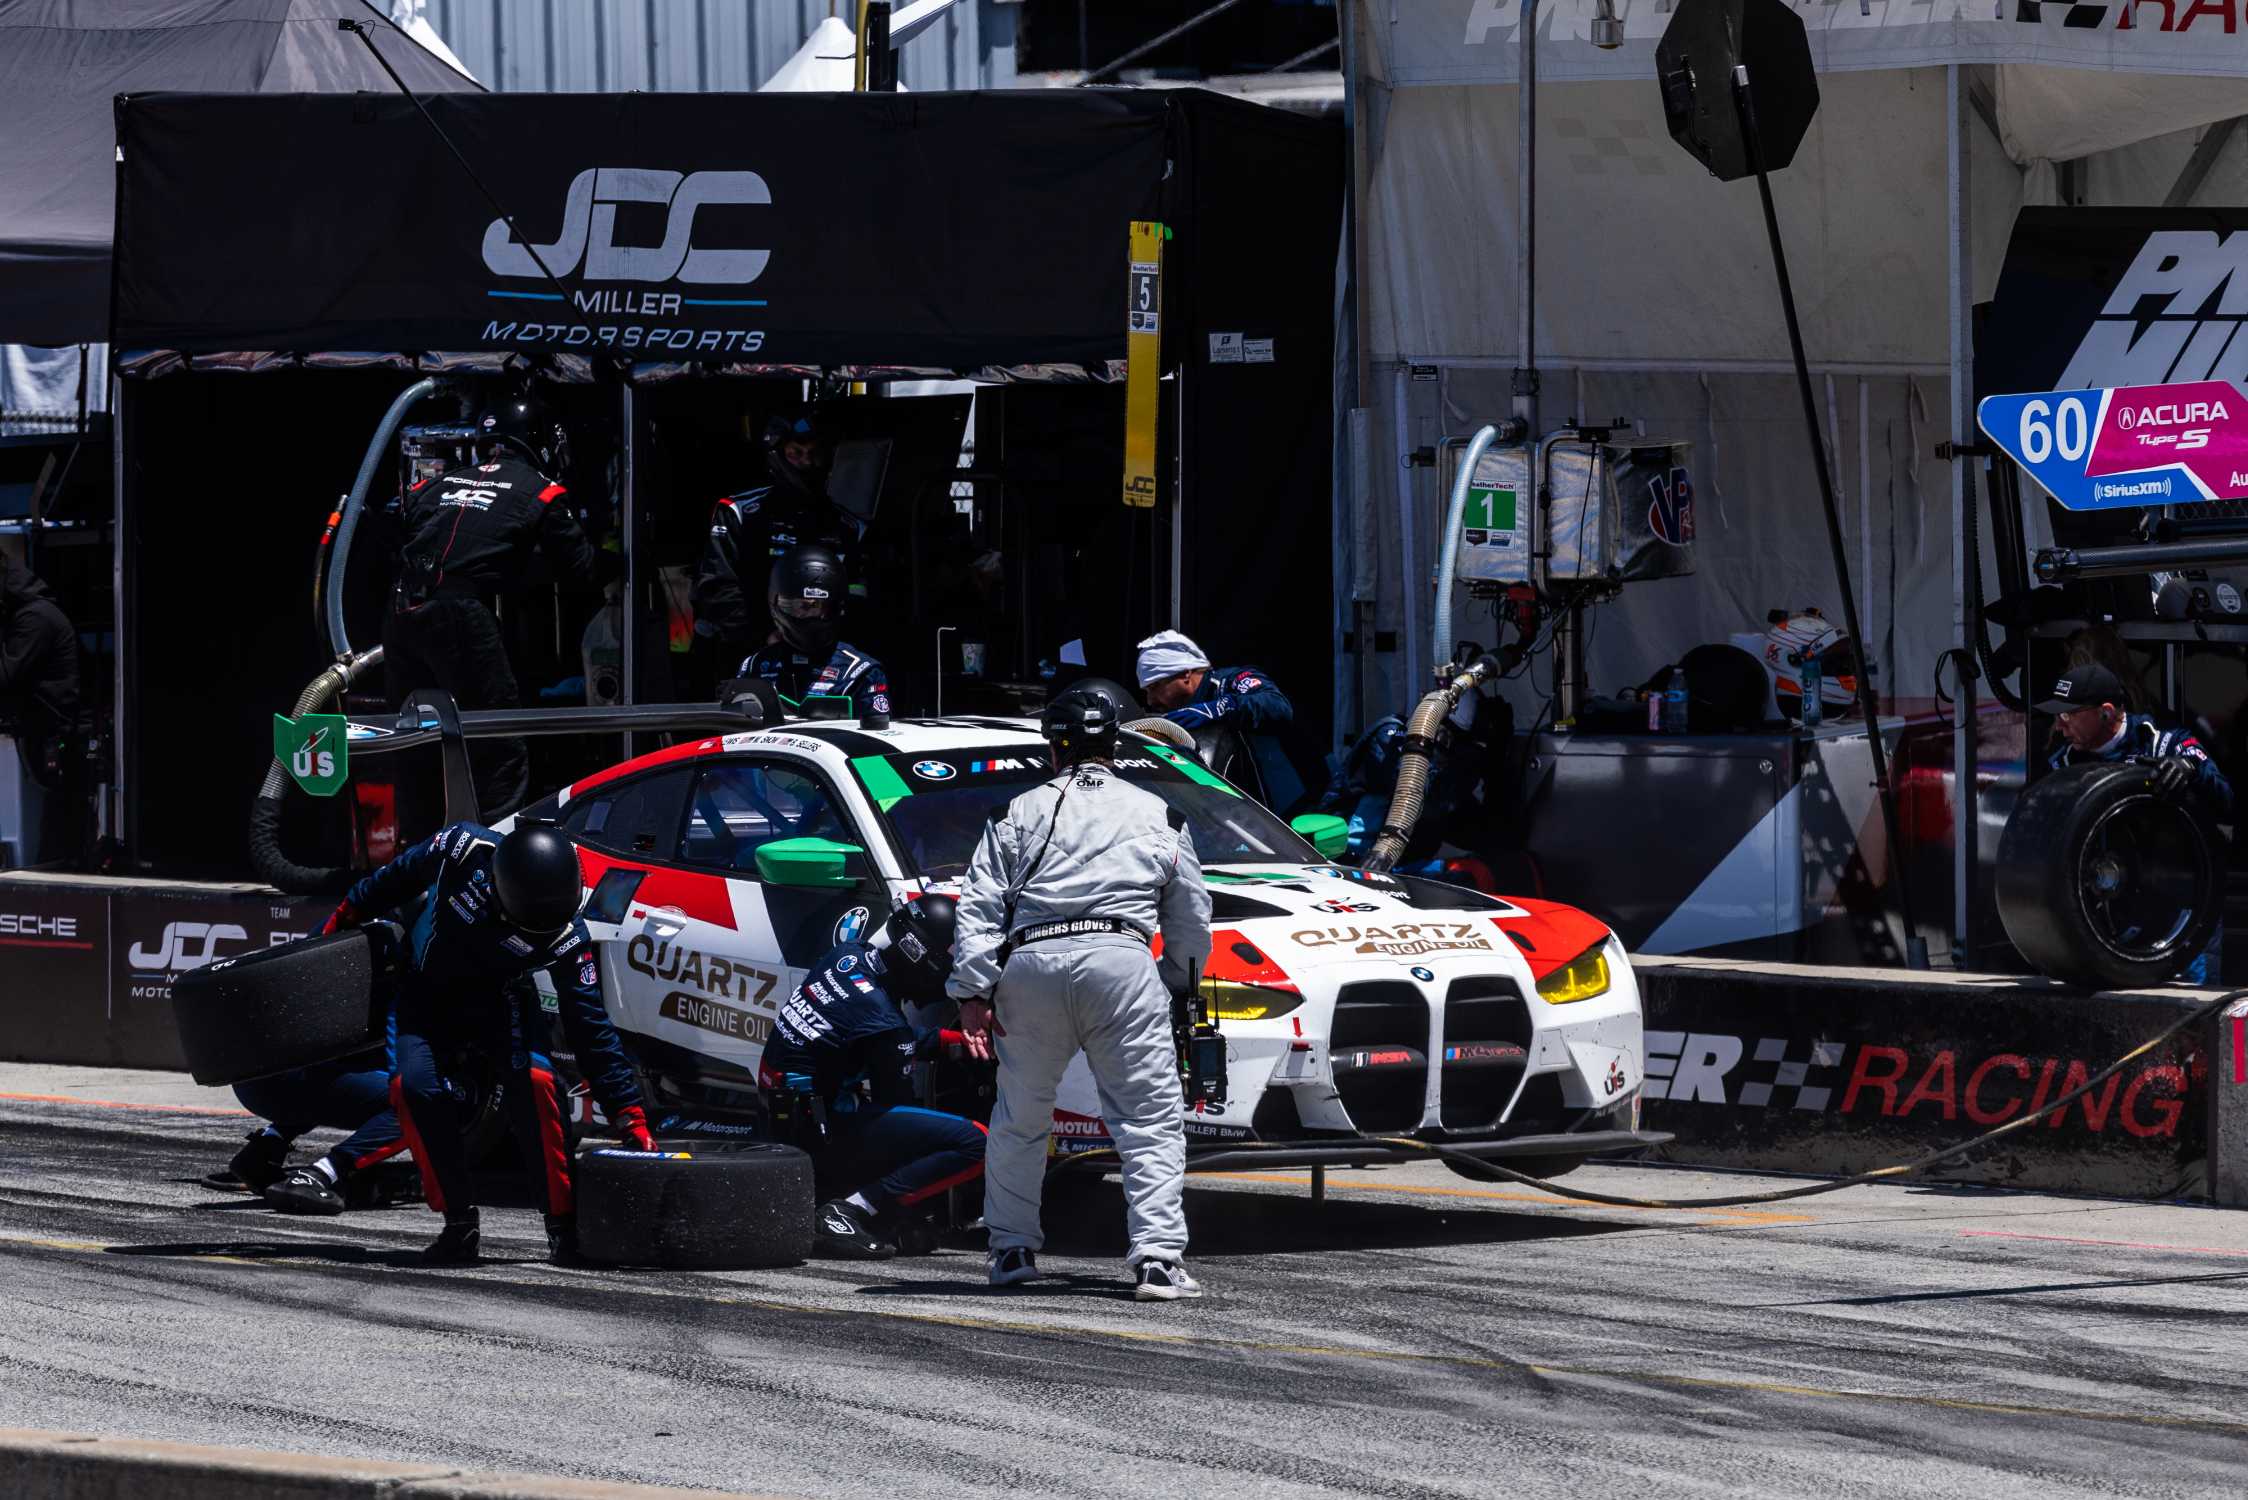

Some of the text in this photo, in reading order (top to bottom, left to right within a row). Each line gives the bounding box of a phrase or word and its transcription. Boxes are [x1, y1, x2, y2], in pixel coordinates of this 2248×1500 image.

[482, 168, 771, 284] JDC
[574, 290, 681, 316] MILLER
[1140, 276, 1150, 311] 5
[482, 320, 766, 352] MOTORSPORTS
[2136, 401, 2229, 427] ACURA
[2019, 397, 2088, 464] 60
[2136, 428, 2211, 450] Type S
[443, 476, 512, 490] PORSCHE
[1472, 481, 1514, 490] eatherTech
[1481, 492, 1494, 527] 1
[271, 907, 290, 918] TEAM
[1071, 919, 1112, 931] GLOVES
[128, 921, 248, 970] JDC
[1291, 923, 1482, 948] QUARTZ
[1375, 941, 1450, 956] ENGINE
[627, 933, 778, 1012] QUARTZ
[676, 996, 739, 1033] ENGINE
[743, 1015, 769, 1042] OIL
[1643, 1030, 1743, 1104] ER
[1840, 1043, 2190, 1138] RACING
[699, 1121, 752, 1136] Motorsport
[1053, 1120, 1101, 1134] MOTUL
[1184, 1126, 1246, 1138] MILLER BMW
